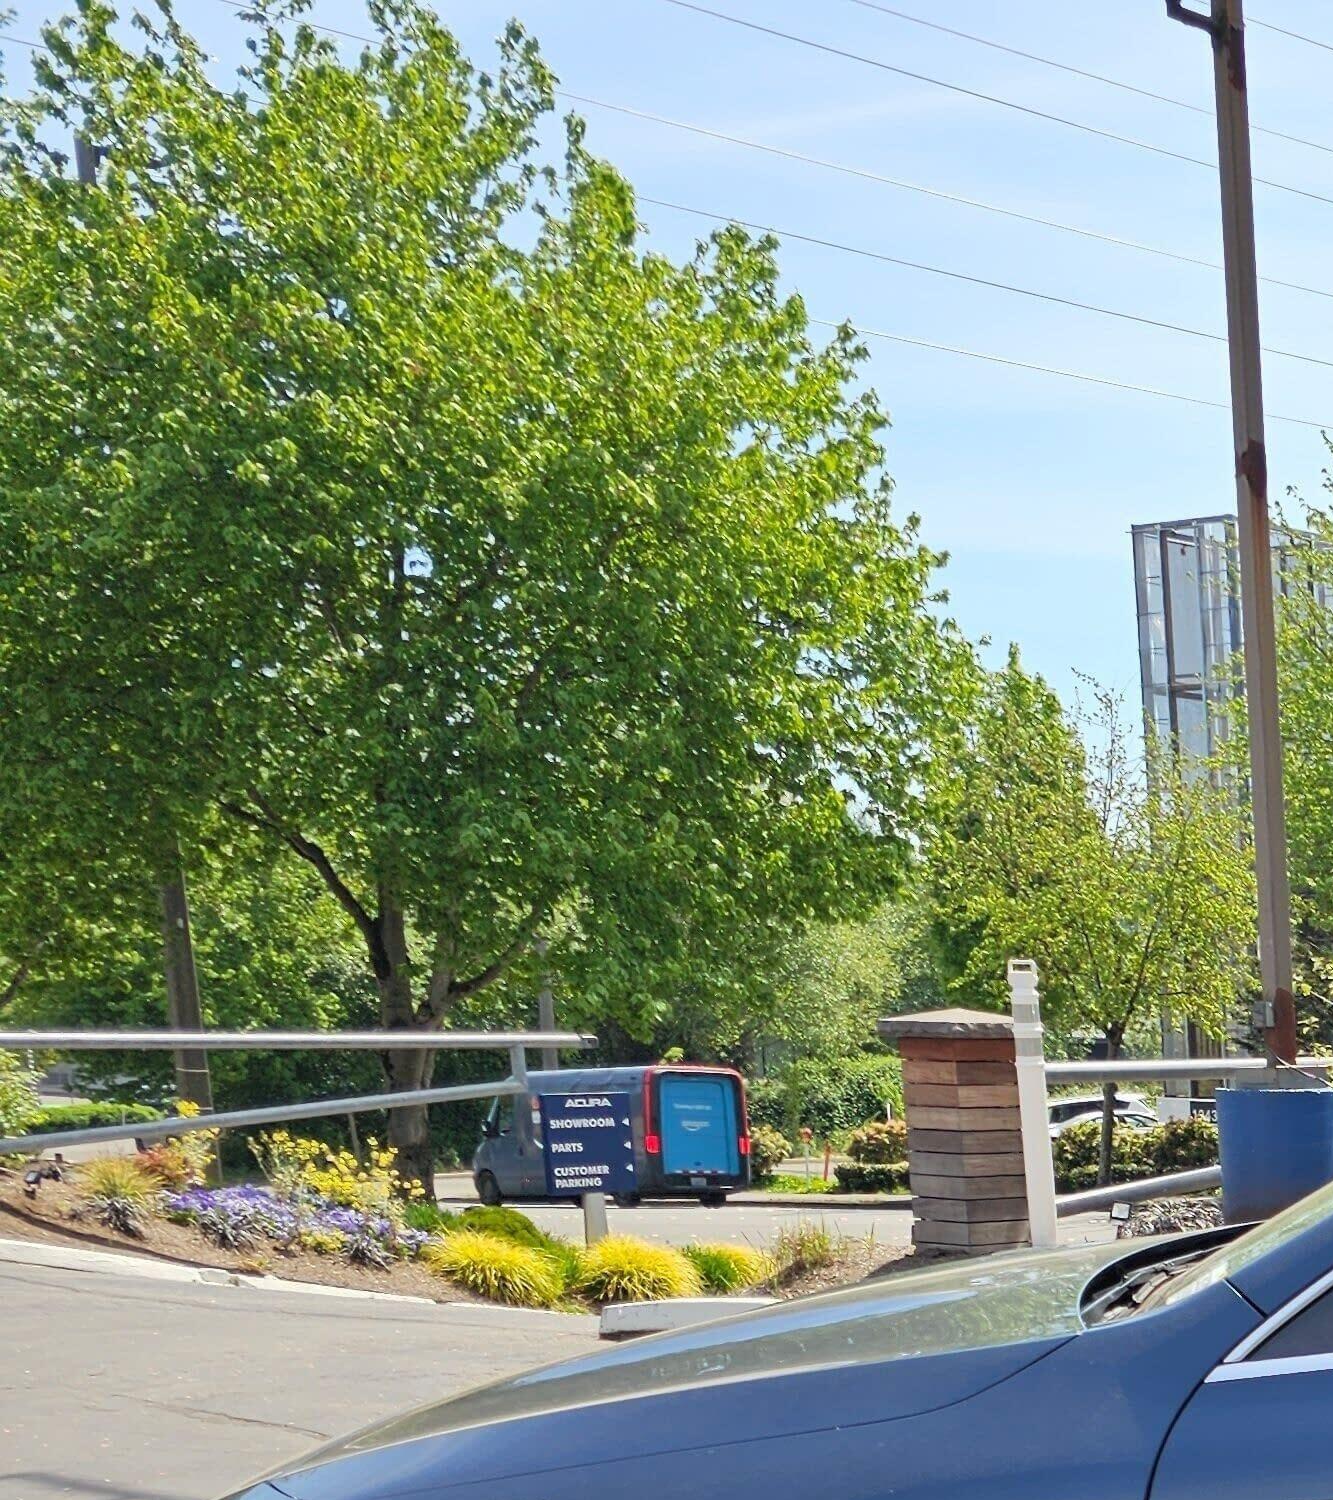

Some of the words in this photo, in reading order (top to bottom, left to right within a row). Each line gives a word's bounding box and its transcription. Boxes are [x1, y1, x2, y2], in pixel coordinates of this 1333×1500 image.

[564, 1097, 612, 1108] ACURA
[549, 1117, 616, 1129] SHOWROOM
[551, 1142, 584, 1153] PARTS
[554, 1165, 610, 1177] CUSTOMER
[555, 1177, 603, 1189] PARKING
